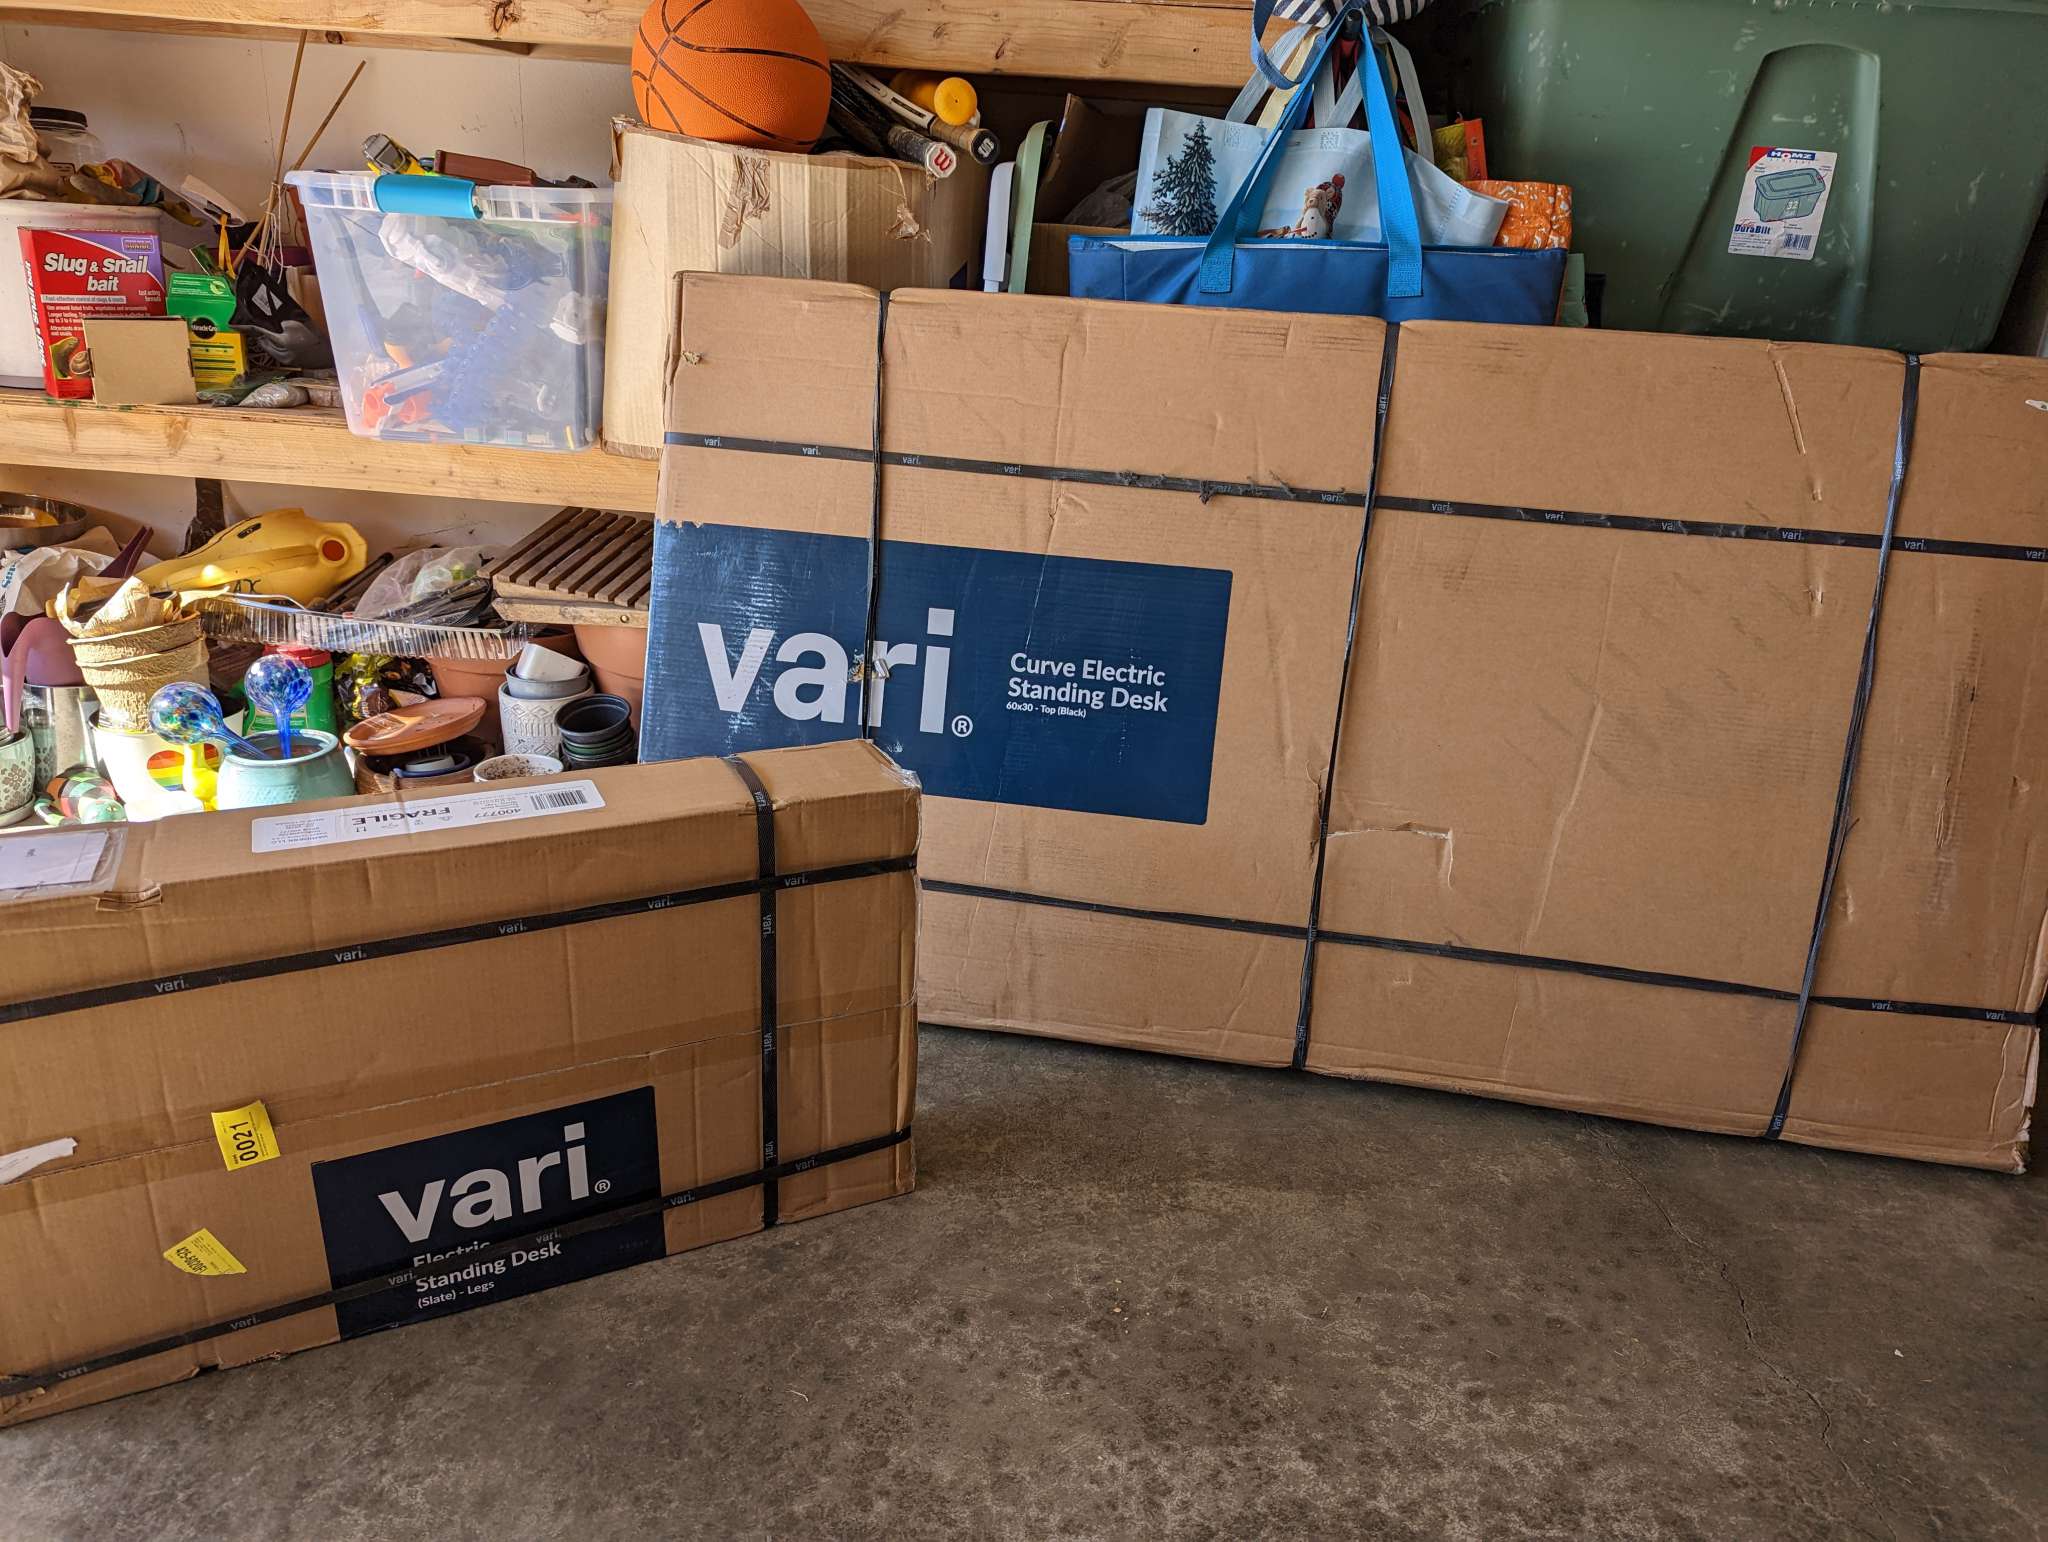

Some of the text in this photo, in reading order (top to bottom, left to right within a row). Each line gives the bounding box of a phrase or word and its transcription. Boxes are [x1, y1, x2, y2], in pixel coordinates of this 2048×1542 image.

[1771, 151, 1812, 160] HOMZ
[44, 253, 149, 276] Slug & Snail
[87, 276, 120, 292] bait
[1010, 652, 1166, 687] Curve Electric
[1007, 677, 1169, 713] Standing Desk
[1006, 701, 1034, 712] 60x30
[1040, 704, 1056, 716] Top
[1057, 706, 1087, 719] (Black)
[352, 806, 451, 826] FRAGILE
[474, 808, 521, 820] 400777
[229, 1121, 259, 1161] 0021
[415, 1241, 562, 1293] Standing Desk
[417, 1290, 457, 1310] (Slate)
[467, 1280, 495, 1297] Legs
